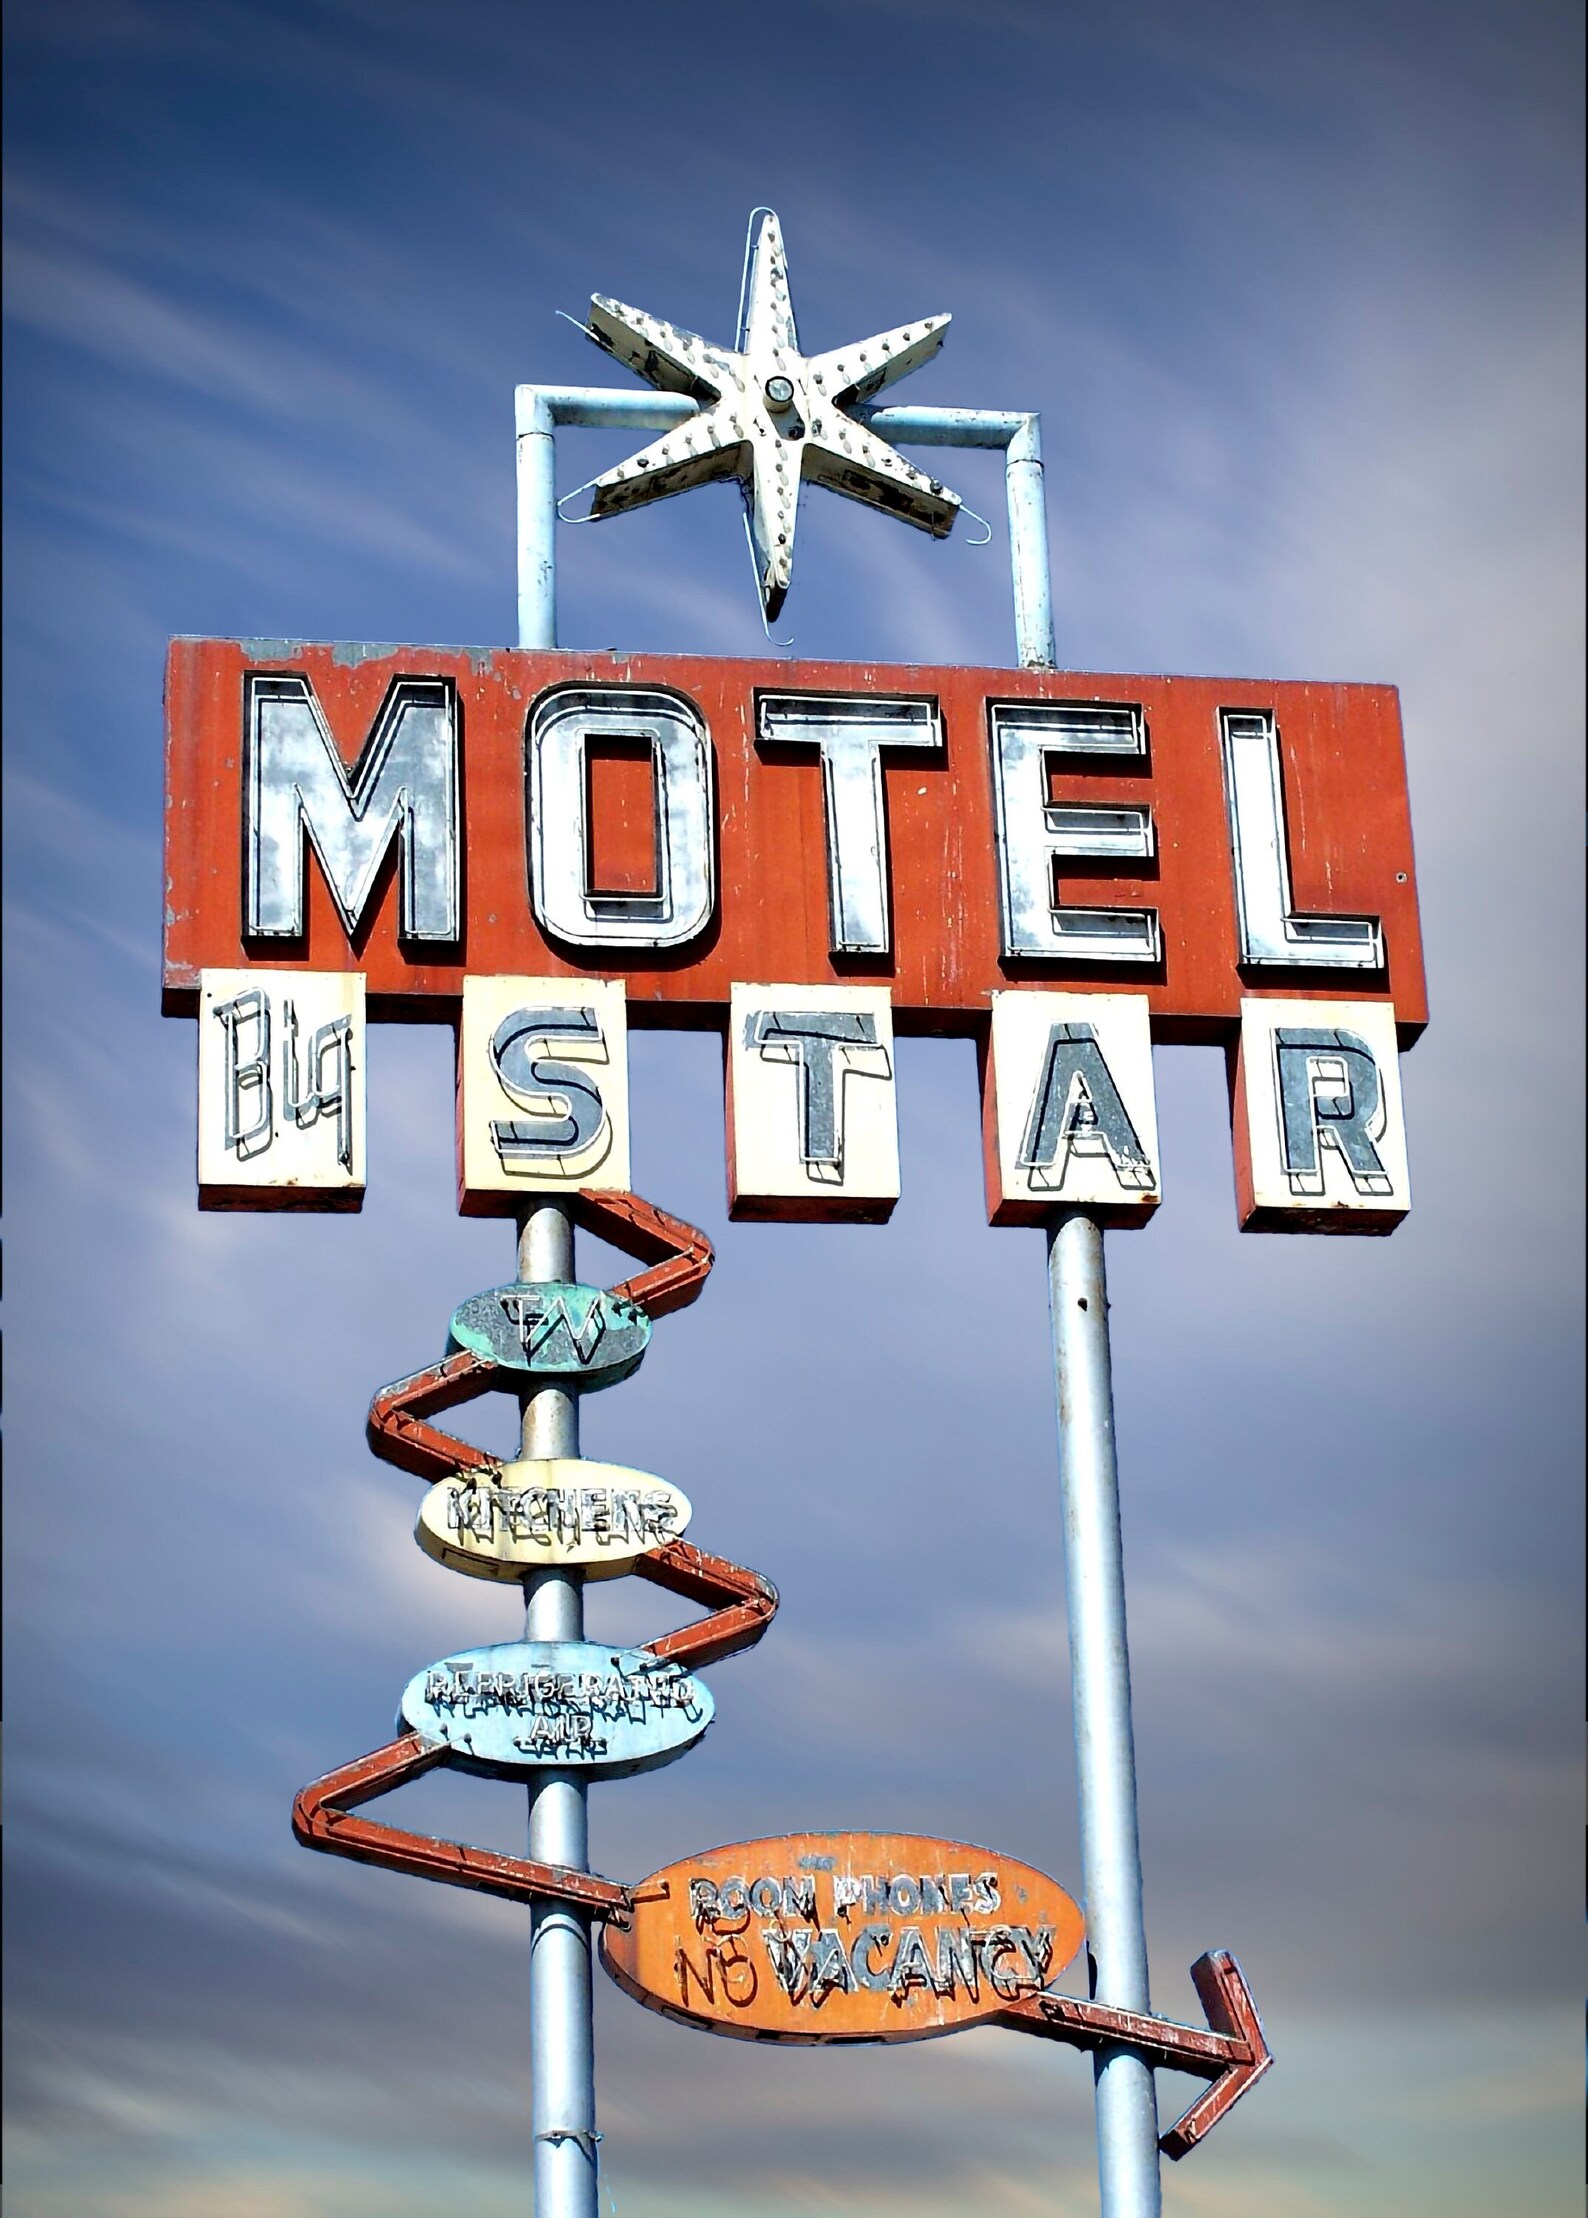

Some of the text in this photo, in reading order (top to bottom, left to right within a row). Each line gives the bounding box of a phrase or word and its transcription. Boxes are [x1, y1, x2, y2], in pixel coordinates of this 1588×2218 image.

[241, 671, 1386, 969] MOTEL
[488, 1005, 1393, 1192] STAR
[500, 1295, 606, 1366] TV
[446, 1485, 678, 1541] KITCHENS
[522, 1715, 602, 1754] AIR
[688, 1872, 1002, 1920] ROOM PHONES
[674, 1923, 1057, 2008] NO VACANCY
